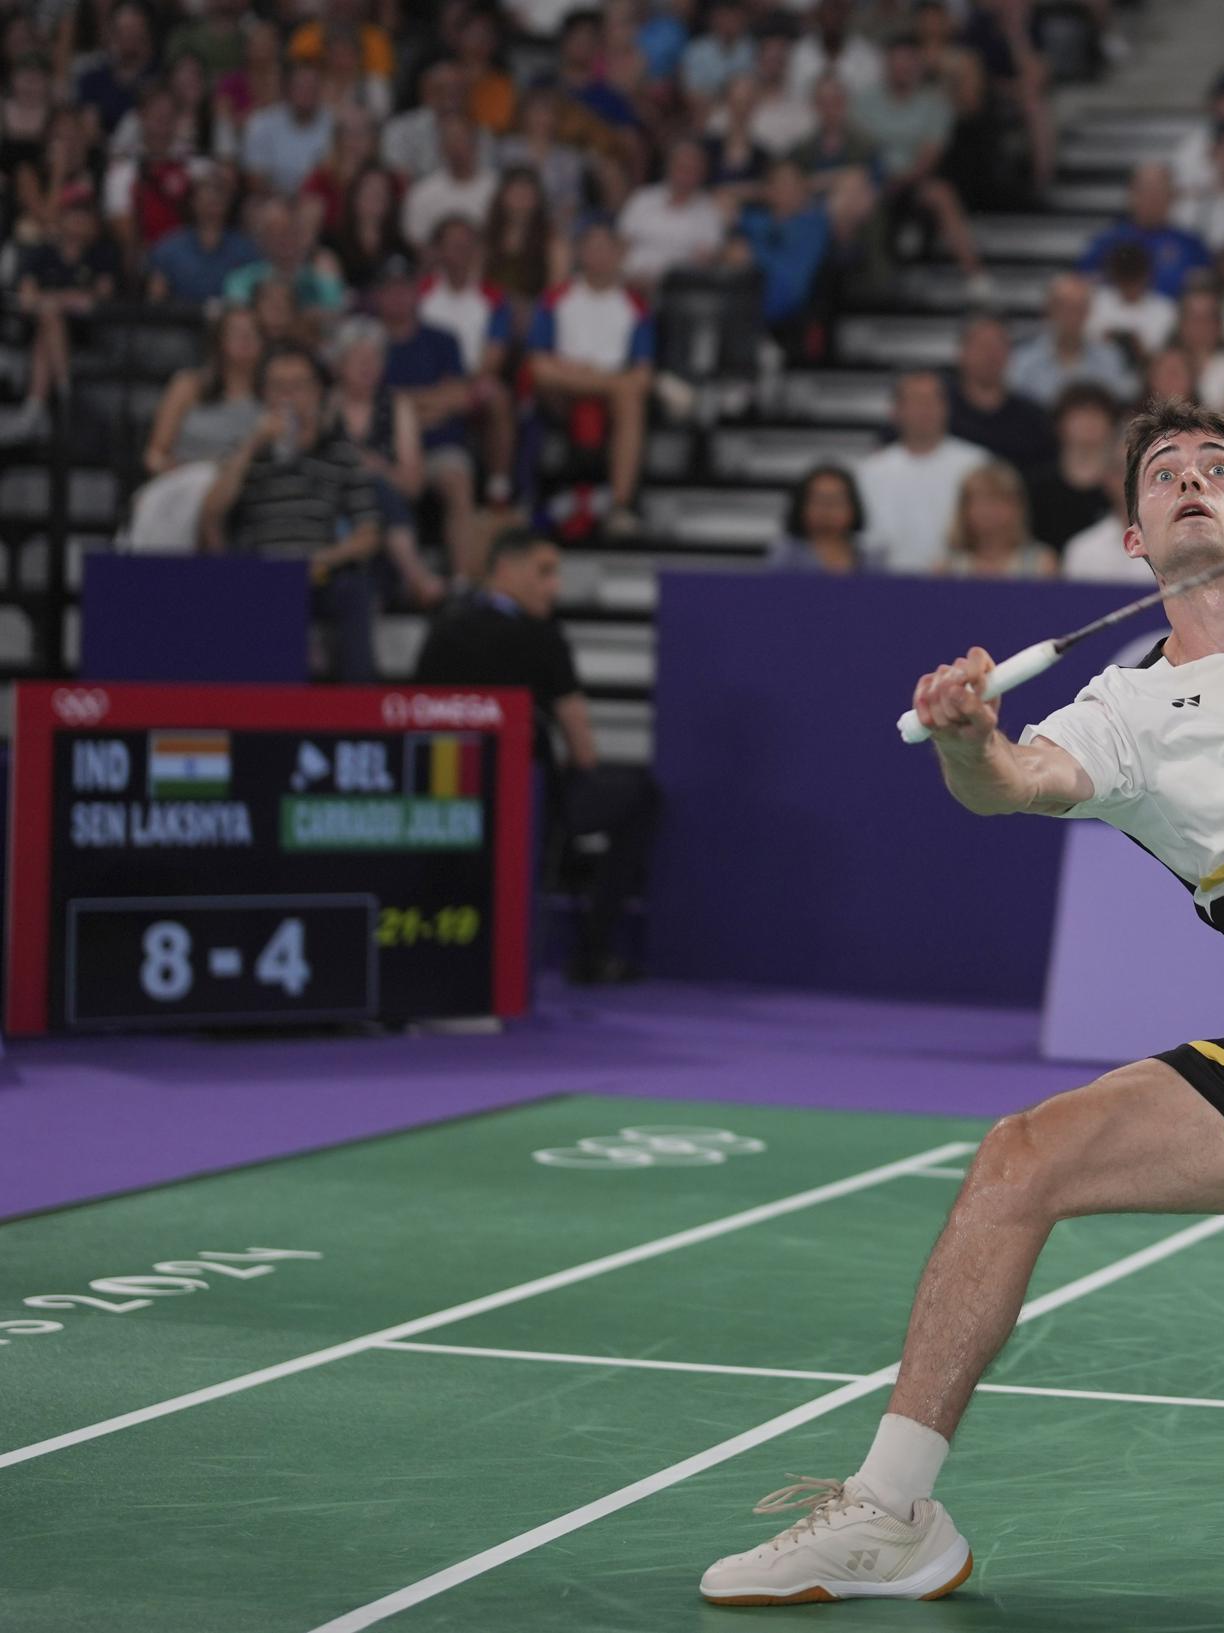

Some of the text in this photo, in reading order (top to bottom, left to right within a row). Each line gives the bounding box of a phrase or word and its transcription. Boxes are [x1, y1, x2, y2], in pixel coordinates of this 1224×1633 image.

[72, 739, 130, 792] IND
[334, 740, 393, 791] BEL
[71, 802, 127, 847] SEN
[22, 1247, 323, 1314] 2024
